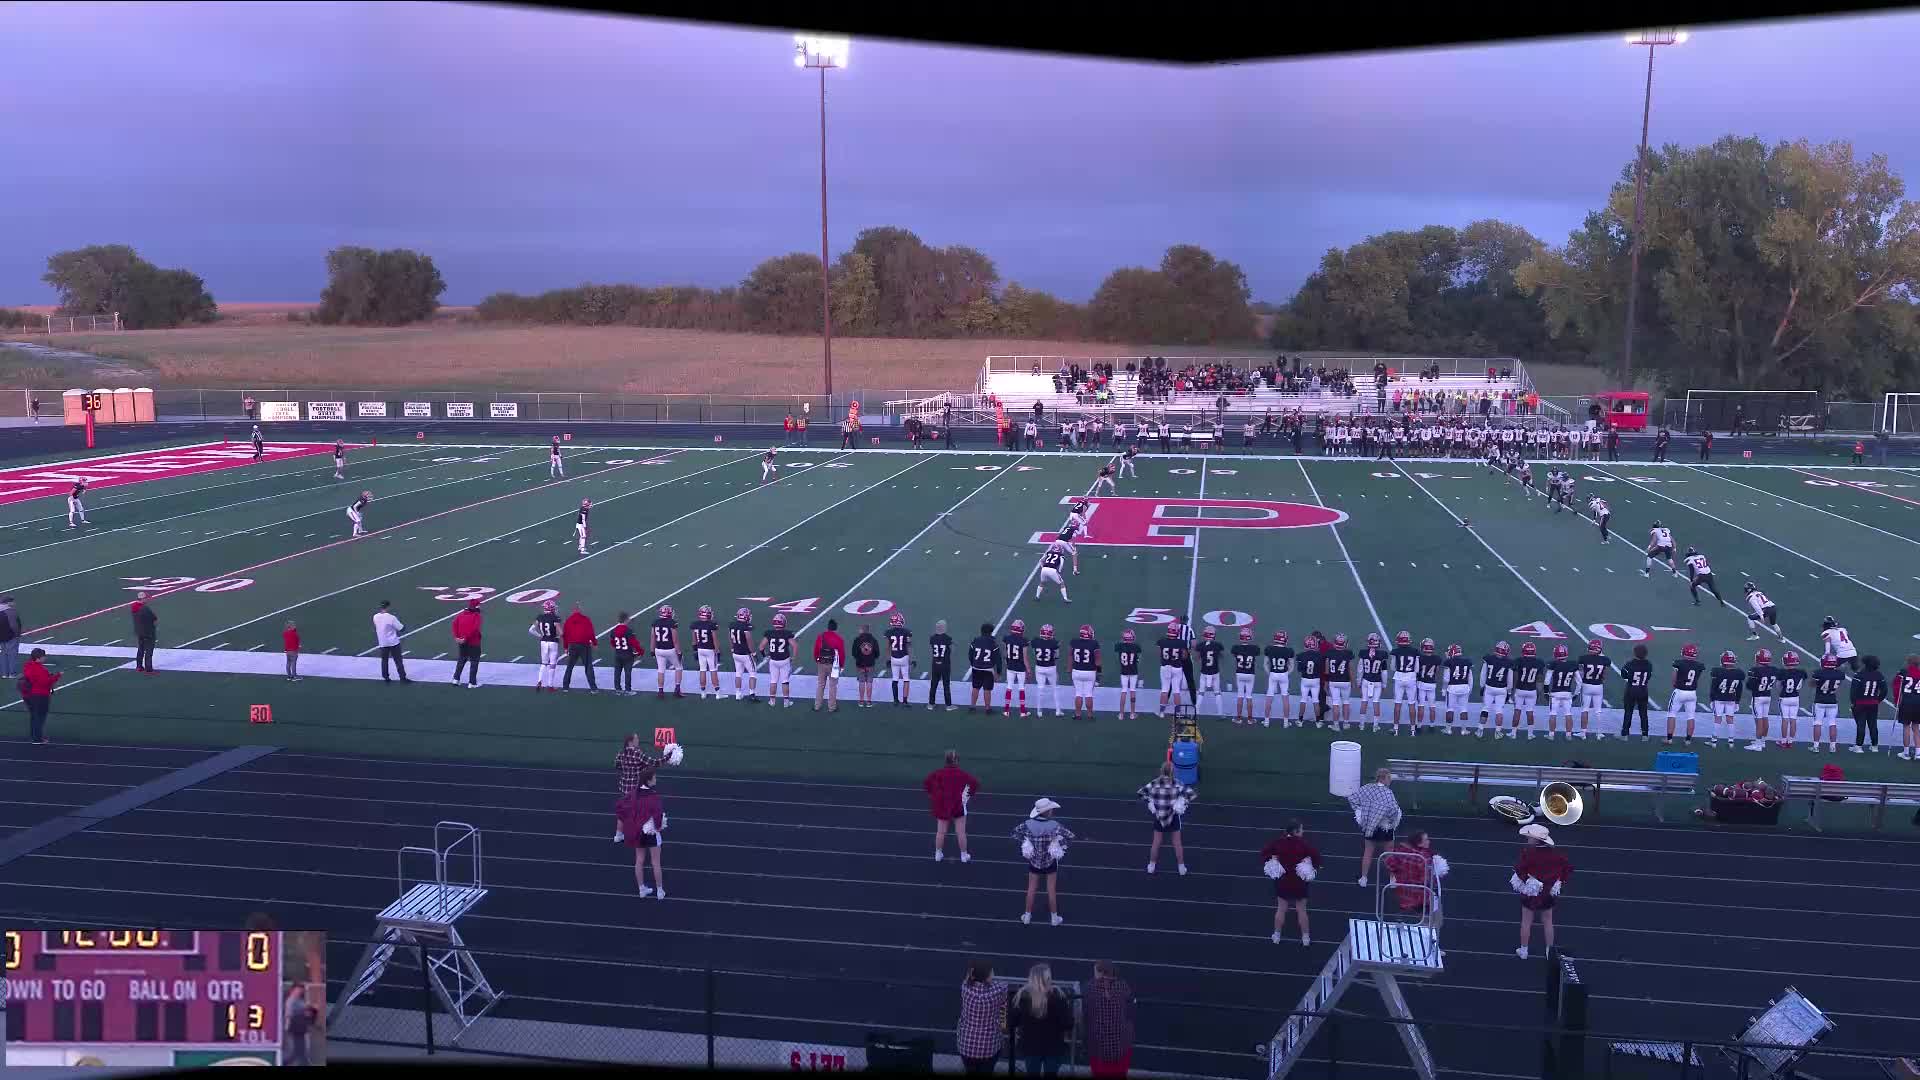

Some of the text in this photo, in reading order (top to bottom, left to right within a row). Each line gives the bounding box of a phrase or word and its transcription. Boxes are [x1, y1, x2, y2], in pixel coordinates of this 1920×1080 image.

[86, 394, 101, 409] 36
[1028, 495, 1350, 547] P
[1045, 553, 1059, 564] 22
[434, 586, 560, 603] 30
[768, 597, 896, 616] 40
[1124, 607, 1257, 627] 50
[539, 622, 551, 636] 13
[654, 626, 669, 642] 52
[1509, 620, 1654, 641] 40
[1839, 630, 1849, 644] 4
[614, 637, 629, 650] 33
[769, 638, 785, 653] 62
[890, 635, 904, 651] 21
[933, 644, 946, 658] 37
[975, 647, 991, 662] 72
[1006, 643, 1019, 660] 15
[1035, 648, 1051, 662] 23
[1073, 648, 1090, 663] 63
[1206, 651, 1214, 666] 5
[1306, 660, 1315, 675] 8
[1329, 659, 1346, 675] 64
[1399, 655, 1414, 672] 12
[1421, 664, 1436, 679] 14
[1452, 665, 1469, 680] 41
[1521, 667, 1538, 683] 10
[1557, 671, 1574, 687] 16
[1586, 664, 1604, 680] 27
[1631, 671, 1648, 686] 51
[1685, 669, 1696, 686] 9
[1863, 680, 1877, 697] 11
[252, 706, 268, 722] 30
[656, 730, 672, 746] 40
[247, 932, 269, 970] 0
[52, 979, 75, 1000] TO
[80, 979, 106, 1000] GO
[129, 980, 169, 1000] BALL
[173, 980, 196, 1000] ON
[207, 980, 244, 1001] QTR
[249, 1004, 264, 1028] 3
